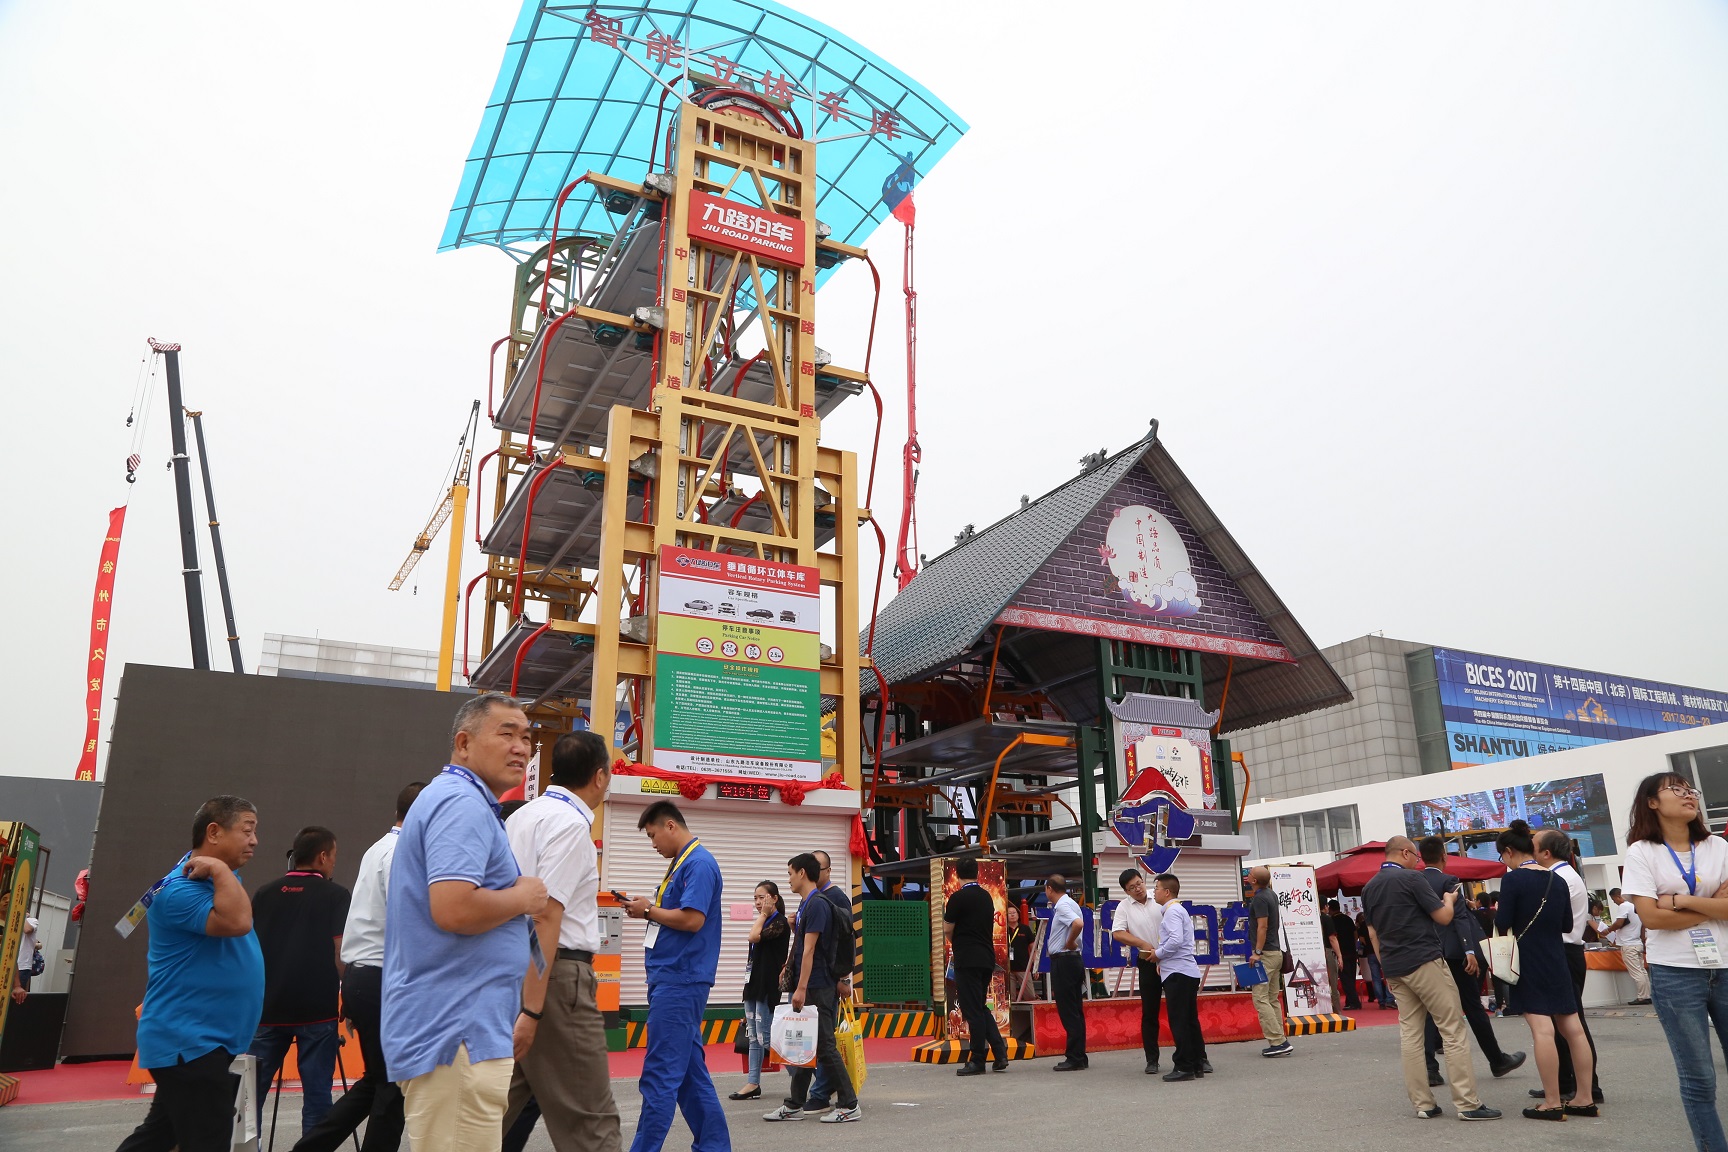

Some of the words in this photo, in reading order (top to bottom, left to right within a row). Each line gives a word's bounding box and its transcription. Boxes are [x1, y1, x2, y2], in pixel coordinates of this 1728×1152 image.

[586, 9, 902, 141] 智能立体车库
[702, 203, 794, 241] 九路泊车
[702, 224, 720, 233] JIU
[722, 228, 749, 241] ROAD
[750, 236, 794, 253] PARKING
[667, 247, 688, 391] 中国制造
[800, 280, 815, 419] 九路品质
[1135, 518, 1148, 579] 中国制造
[727, 561, 806, 582] 垂直循环立体车库
[766, 578, 787, 586] Parking
[1465, 662, 1505, 688] BICES
[1507, 669, 1537, 693] 2017
[1453, 733, 1530, 758] SHANTUI
